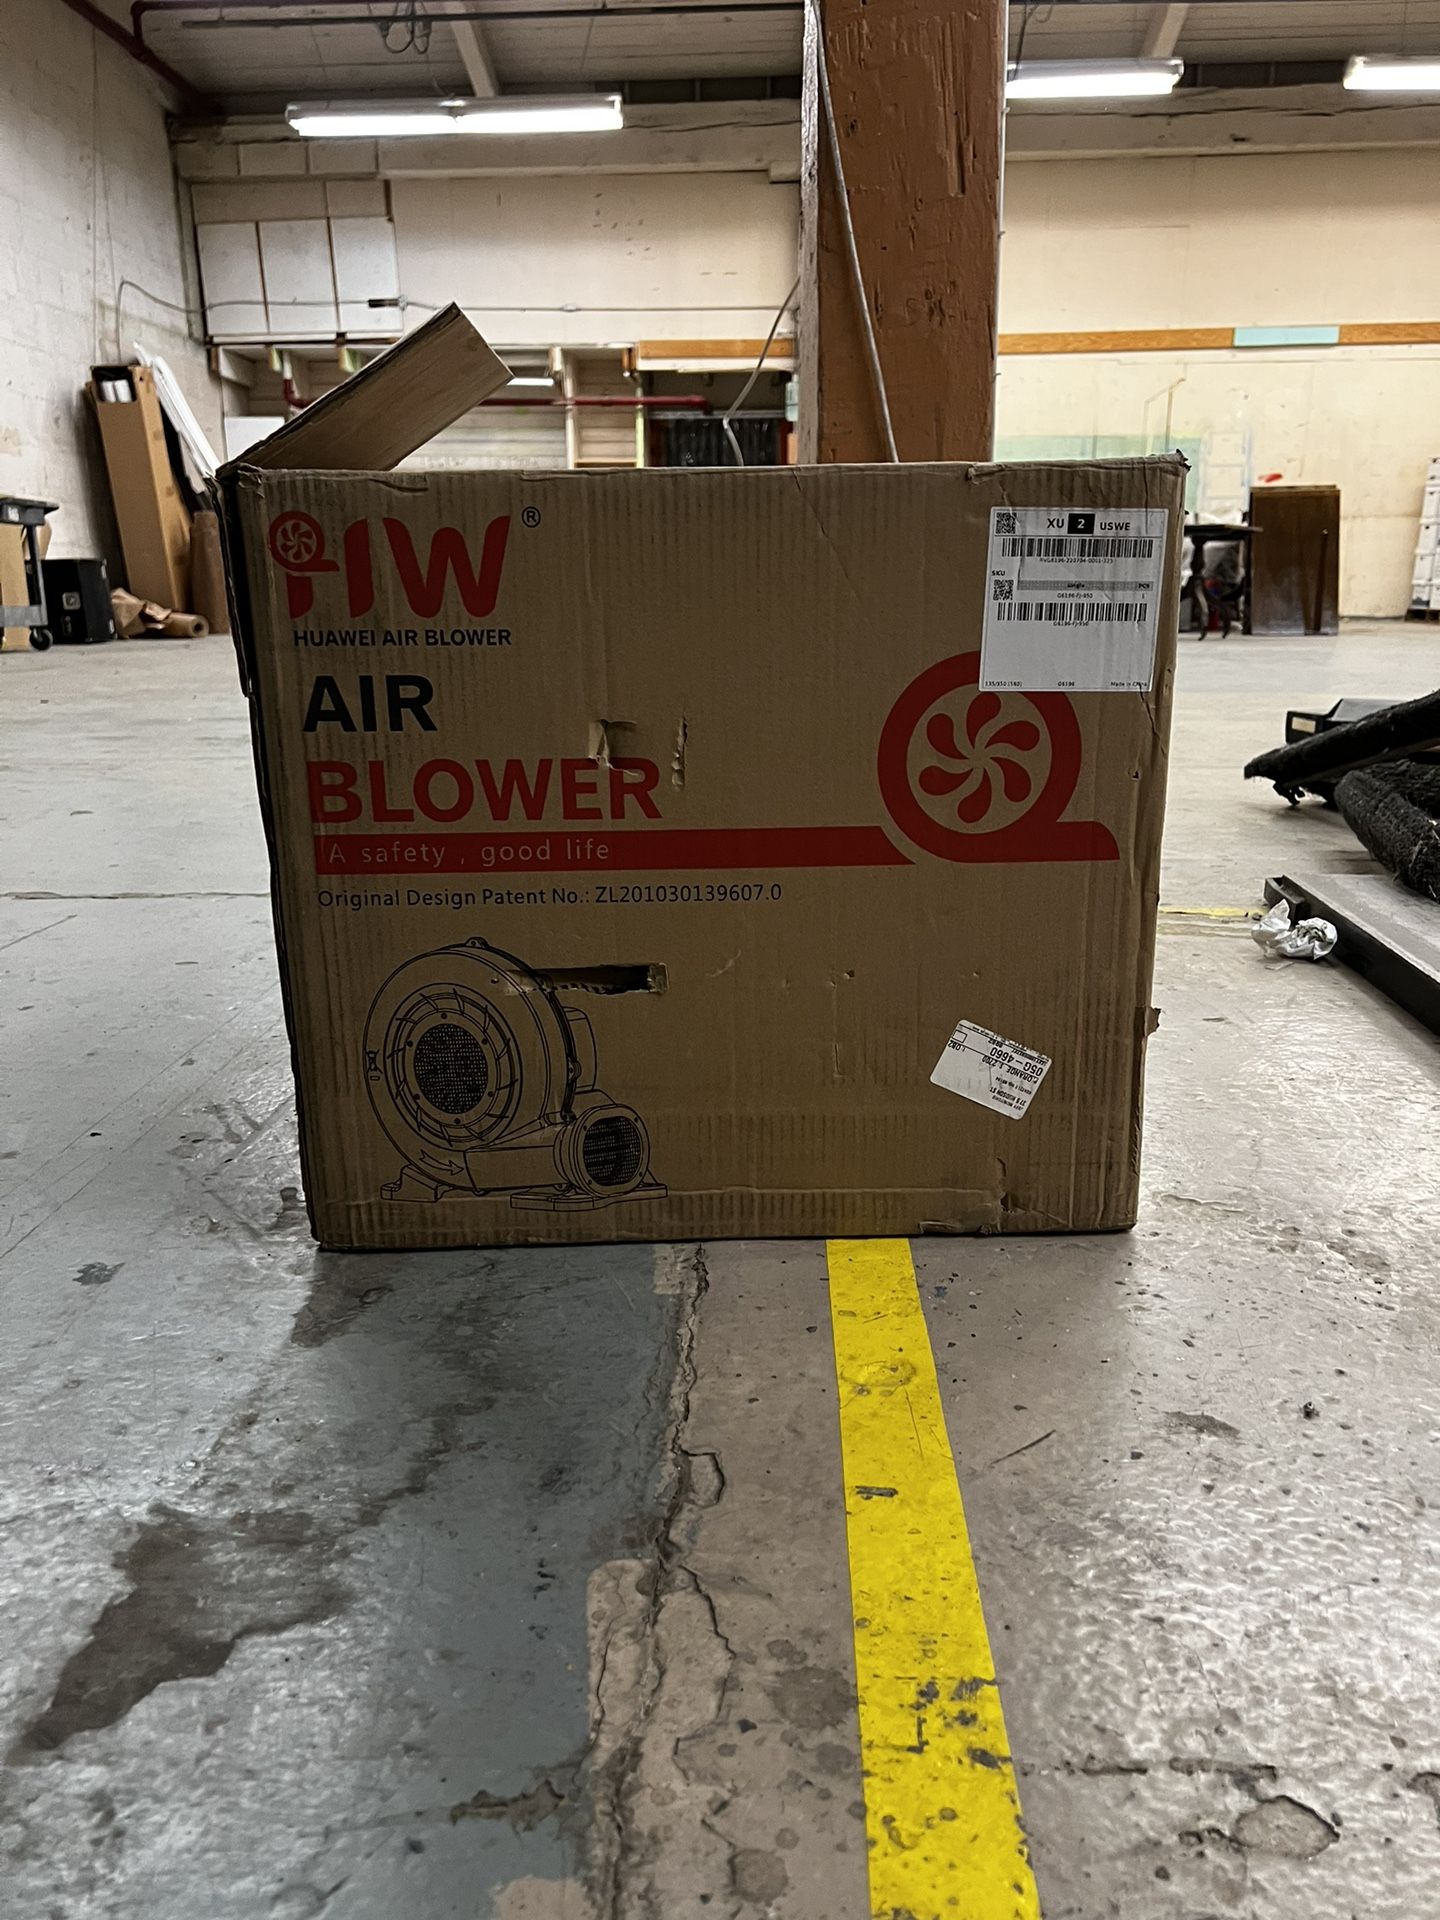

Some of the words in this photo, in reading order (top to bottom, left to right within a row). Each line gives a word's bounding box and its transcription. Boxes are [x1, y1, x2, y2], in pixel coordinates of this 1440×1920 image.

[1046, 518, 1065, 529] XU
[1077, 519, 1085, 529] 2
[1100, 522, 1131, 531] USWE
[293, 629, 376, 647] HUAWEI
[382, 629, 418, 647] AIR
[424, 629, 512, 647] BLOWER
[302, 674, 438, 733] AIR
[306, 758, 663, 823] BLOWER
[329, 843, 346, 863] A
[361, 841, 446, 868] safety
[481, 840, 550, 867] good
[566, 839, 610, 860] life
[318, 890, 400, 911] Original
[406, 889, 476, 909] Design
[482, 888, 547, 905] Patent
[552, 888, 590, 904] No.:
[595, 883, 782, 904] ZL201030139607.0
